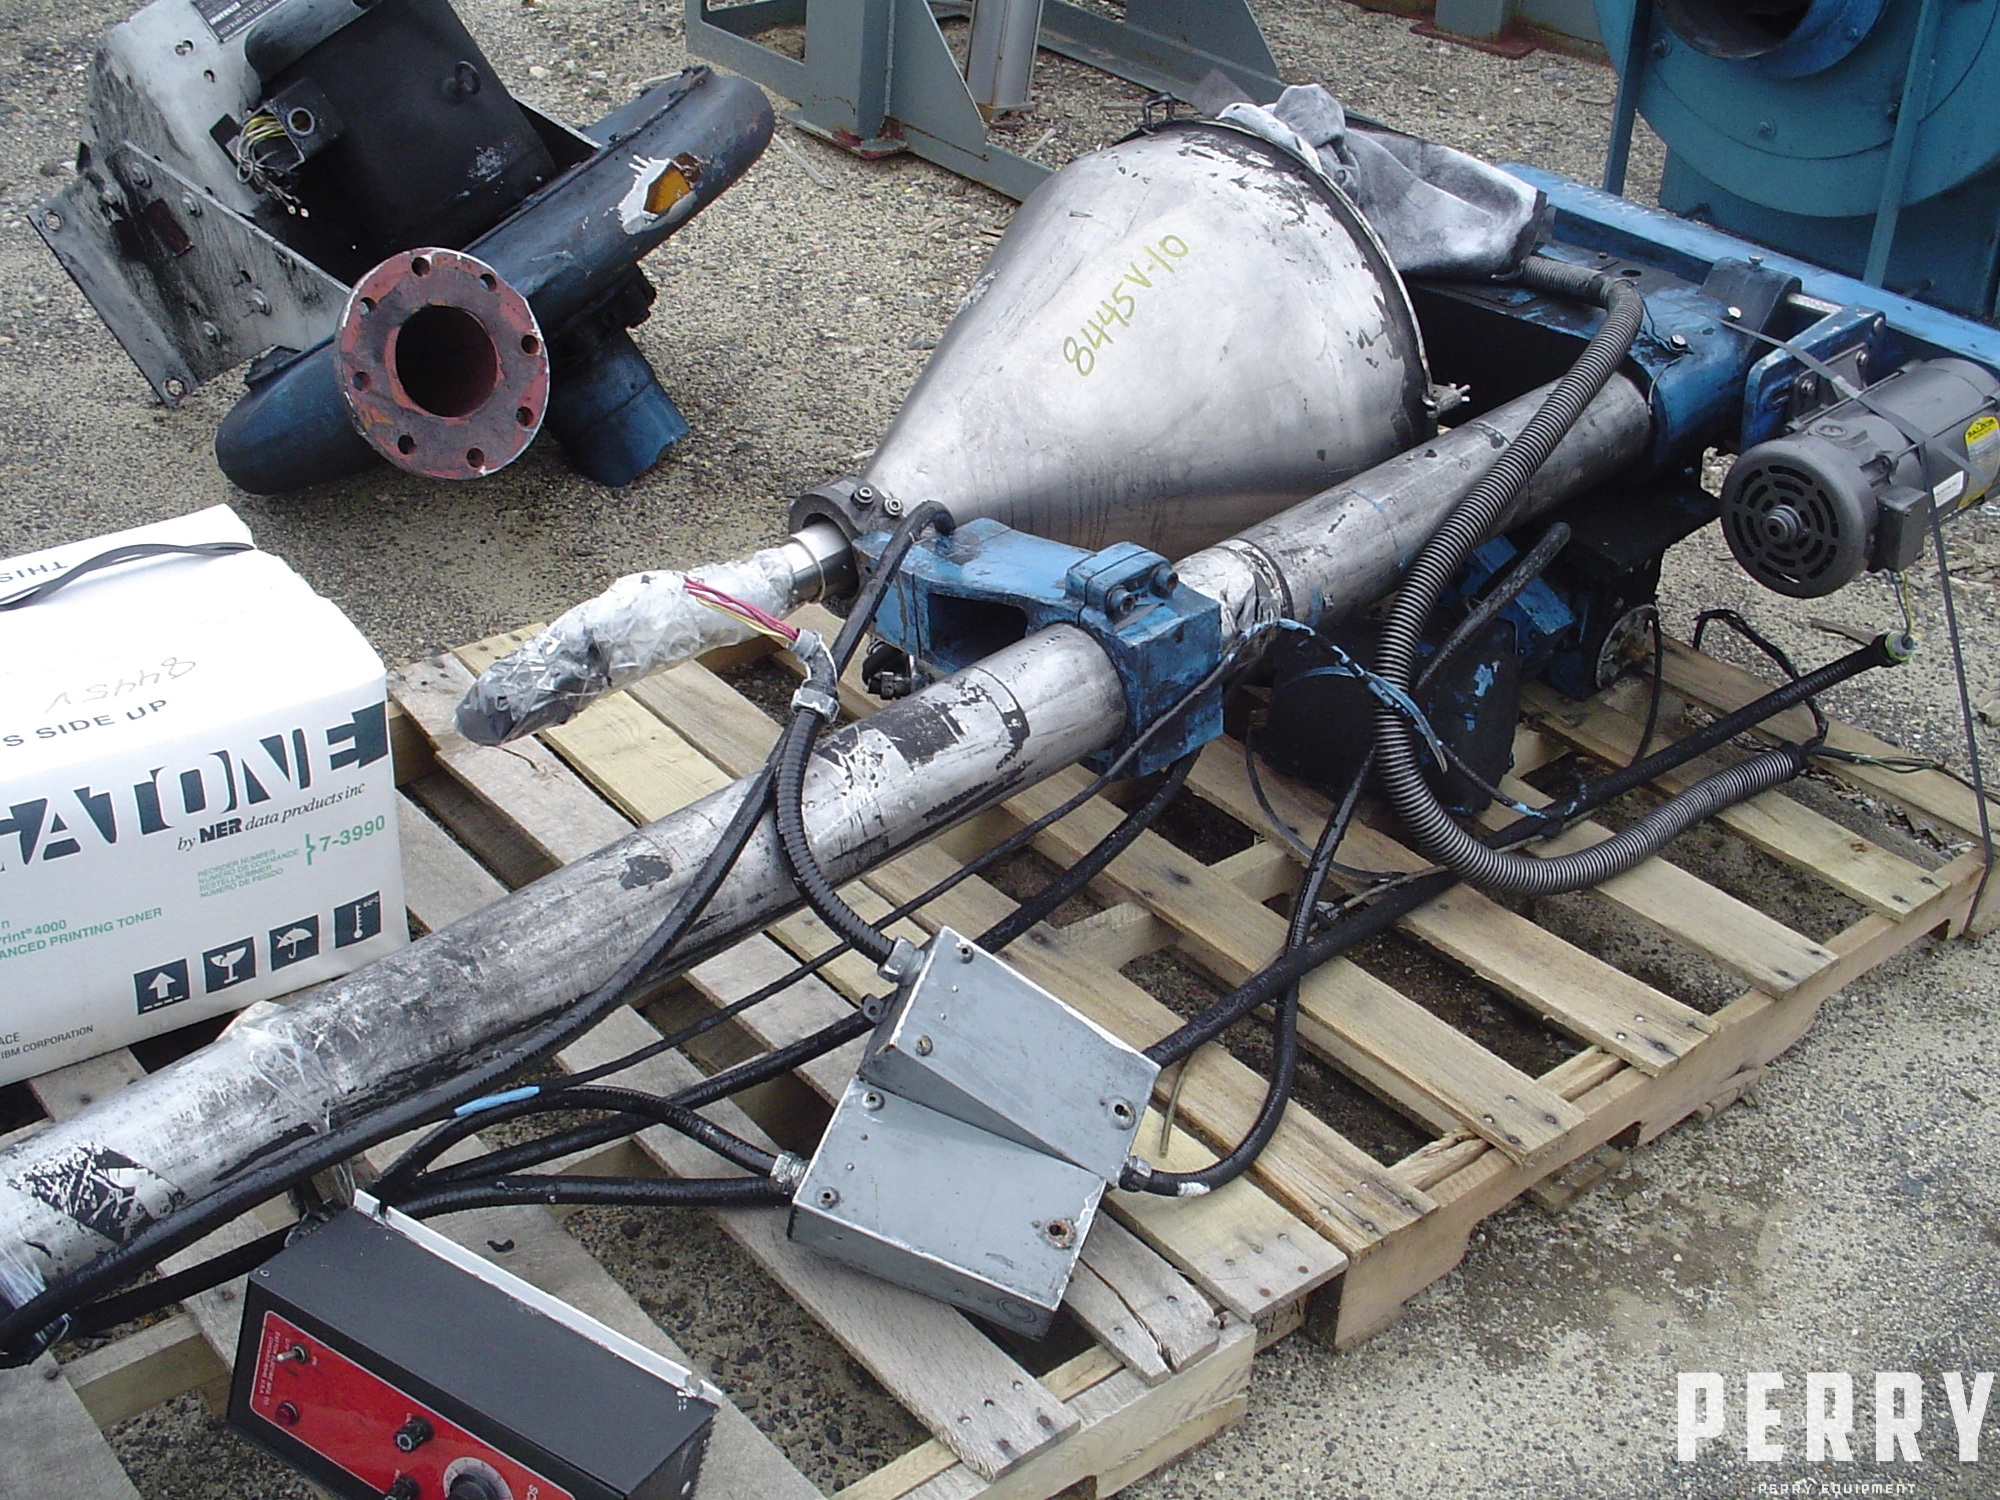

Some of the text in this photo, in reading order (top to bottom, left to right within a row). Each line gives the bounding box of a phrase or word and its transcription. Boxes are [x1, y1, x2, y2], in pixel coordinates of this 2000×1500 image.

[35, 714, 116, 740] SIDE
[125, 699, 168, 720] UP
[177, 783, 366, 852] by NER data products inc
[319, 814, 386, 852] 7-3990
[198, 848, 276, 877] REORDER NUMBER
[250, 848, 300, 869] COMMANDE
[199, 864, 272, 892] BESTELLNUMMER
[238, 878, 250, 888] DE
[252, 867, 284, 883] PEDIDO
[34, 919, 67, 936] 4000
[50, 921, 114, 947] PRINTING
[116, 907, 163, 929] TONER
[1, 1024, 94, 1060] IBM CORPORATION
